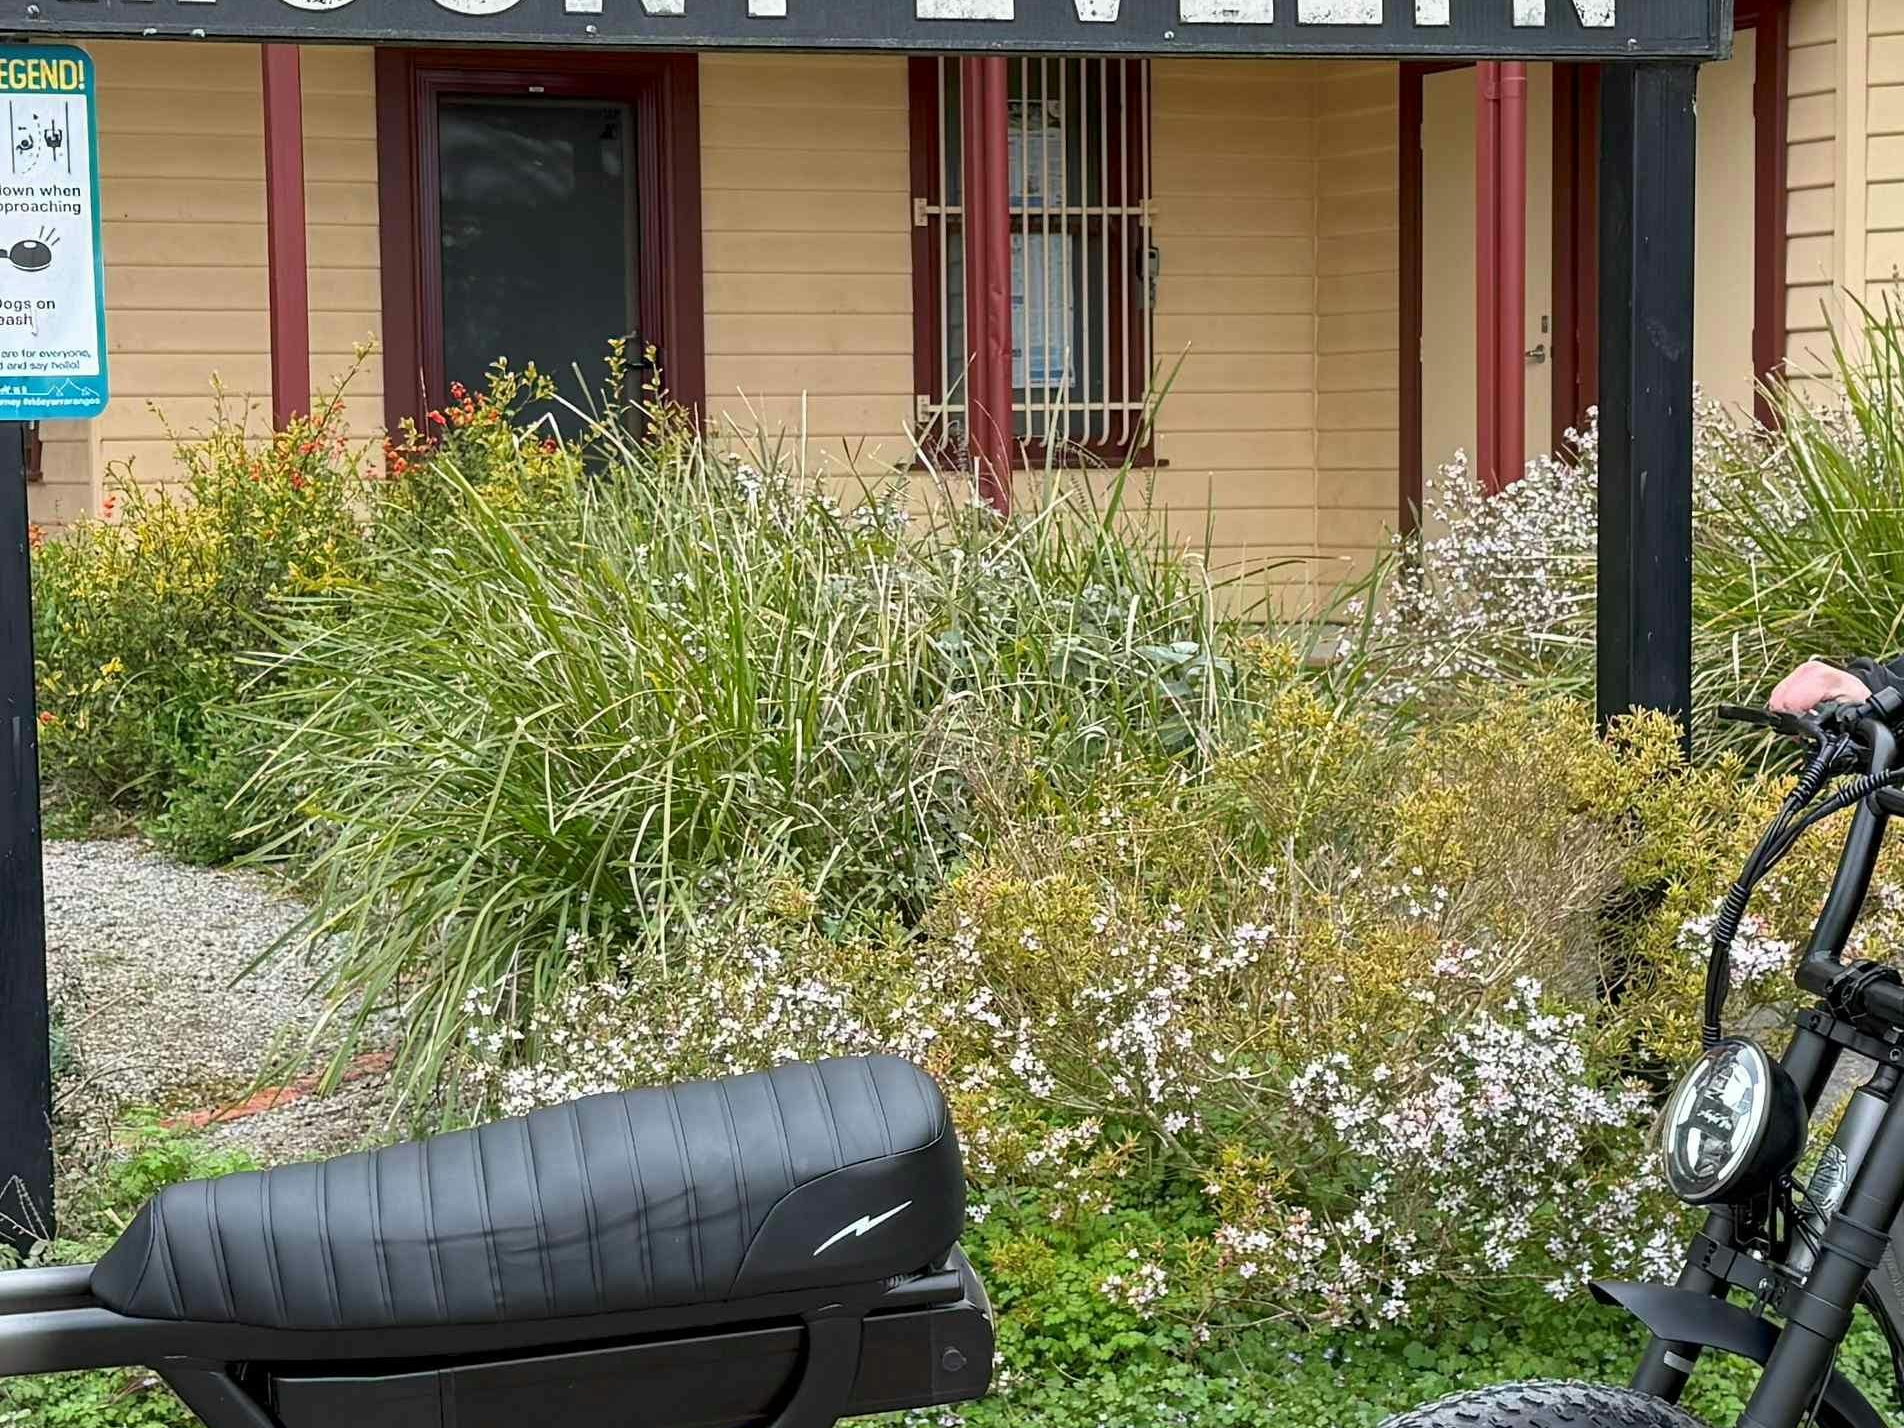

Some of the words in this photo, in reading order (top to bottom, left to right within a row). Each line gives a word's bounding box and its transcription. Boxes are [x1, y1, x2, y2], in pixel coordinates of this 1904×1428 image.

[39, 184, 81, 197] when
[36, 300, 56, 310] on
[1, 350, 18, 359] are
[21, 349, 36, 359] for
[39, 349, 91, 361] everyone,
[7, 361, 27, 371] and
[29, 362, 48, 373] say
[51, 360, 80, 371] hello!
